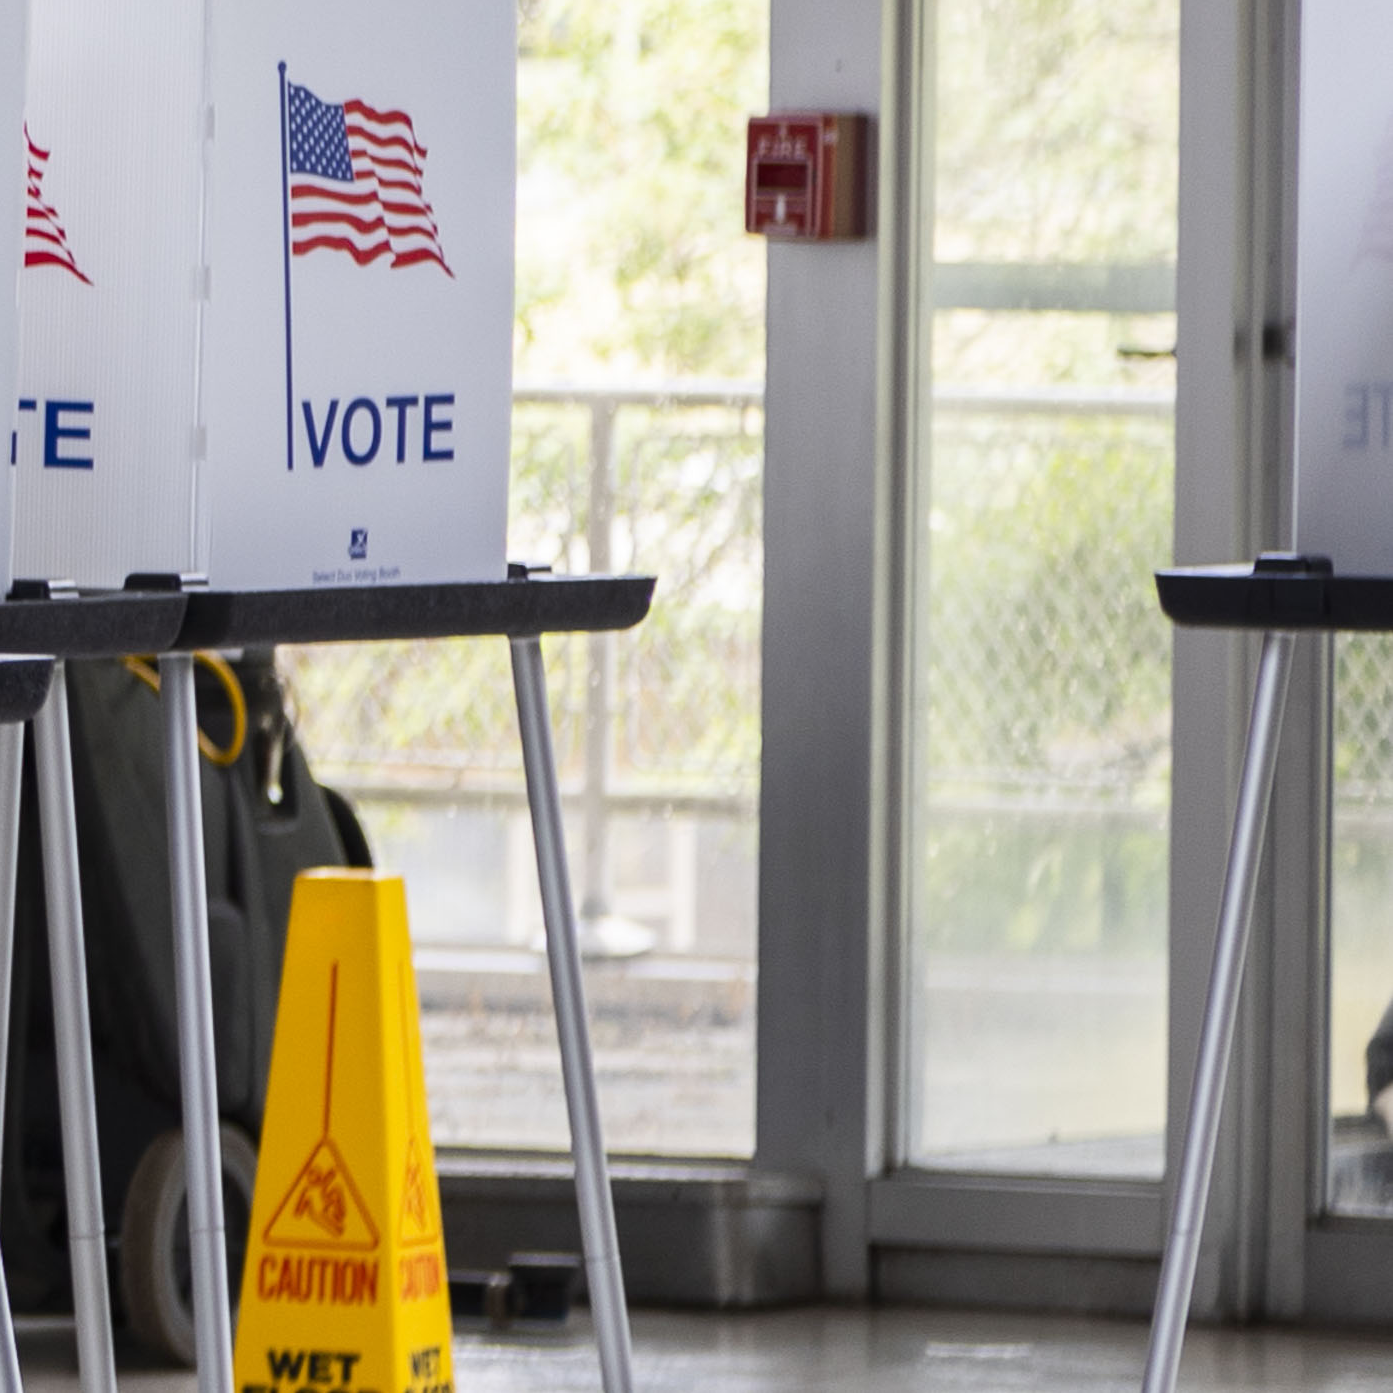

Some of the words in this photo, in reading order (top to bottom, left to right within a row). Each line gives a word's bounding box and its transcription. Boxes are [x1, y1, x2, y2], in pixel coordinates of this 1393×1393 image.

[302, 392, 455, 470] VOTE
[258, 1252, 380, 1306] CAUTION
[268, 1348, 361, 1384] WET
